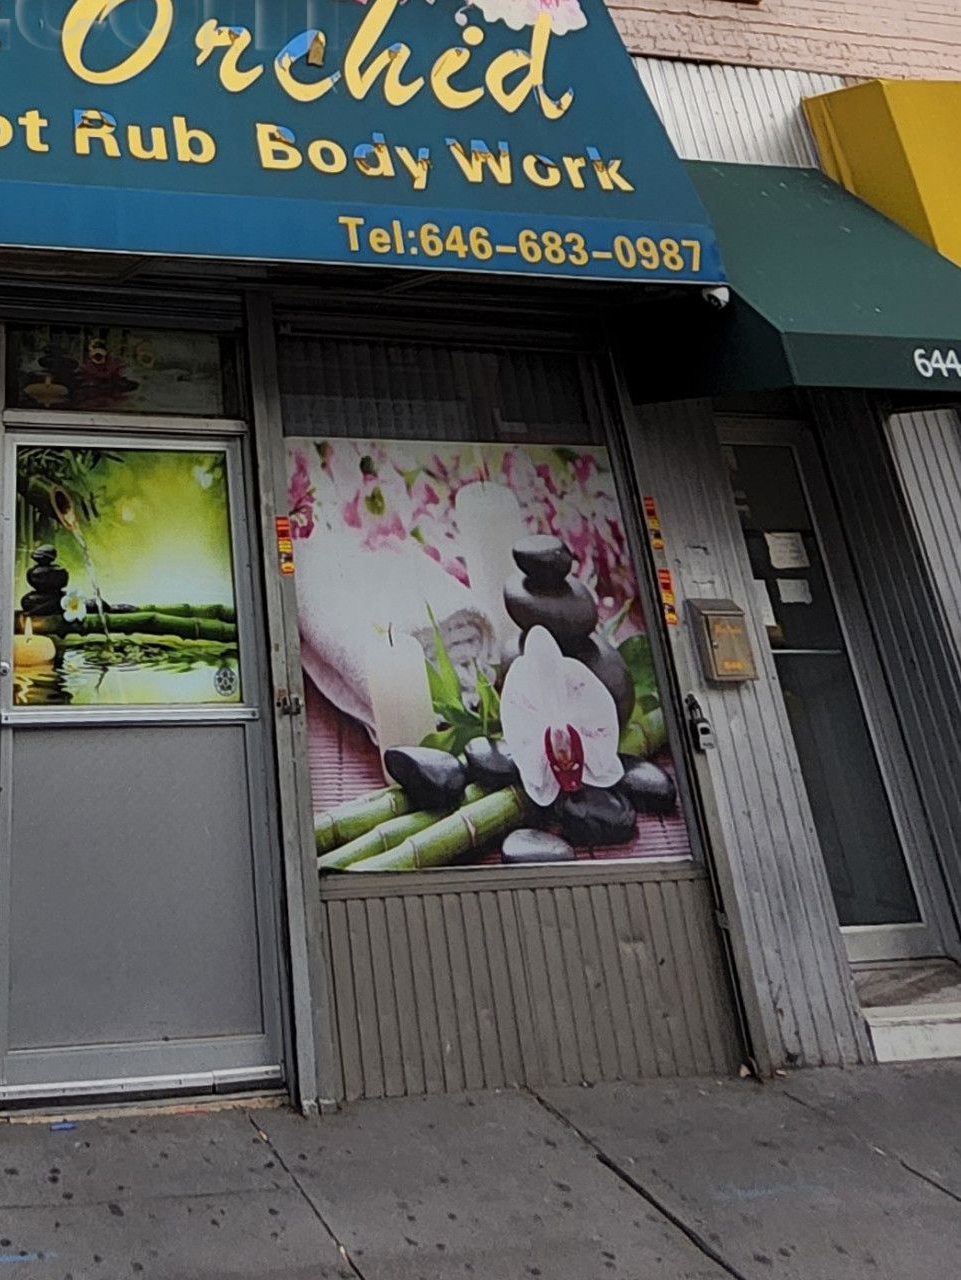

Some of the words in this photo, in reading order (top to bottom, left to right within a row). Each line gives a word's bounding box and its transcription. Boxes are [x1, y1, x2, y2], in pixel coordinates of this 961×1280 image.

[73, 108, 216, 164] Rub
[256, 122, 431, 191] Body
[913, 347, 961, 378] 644
